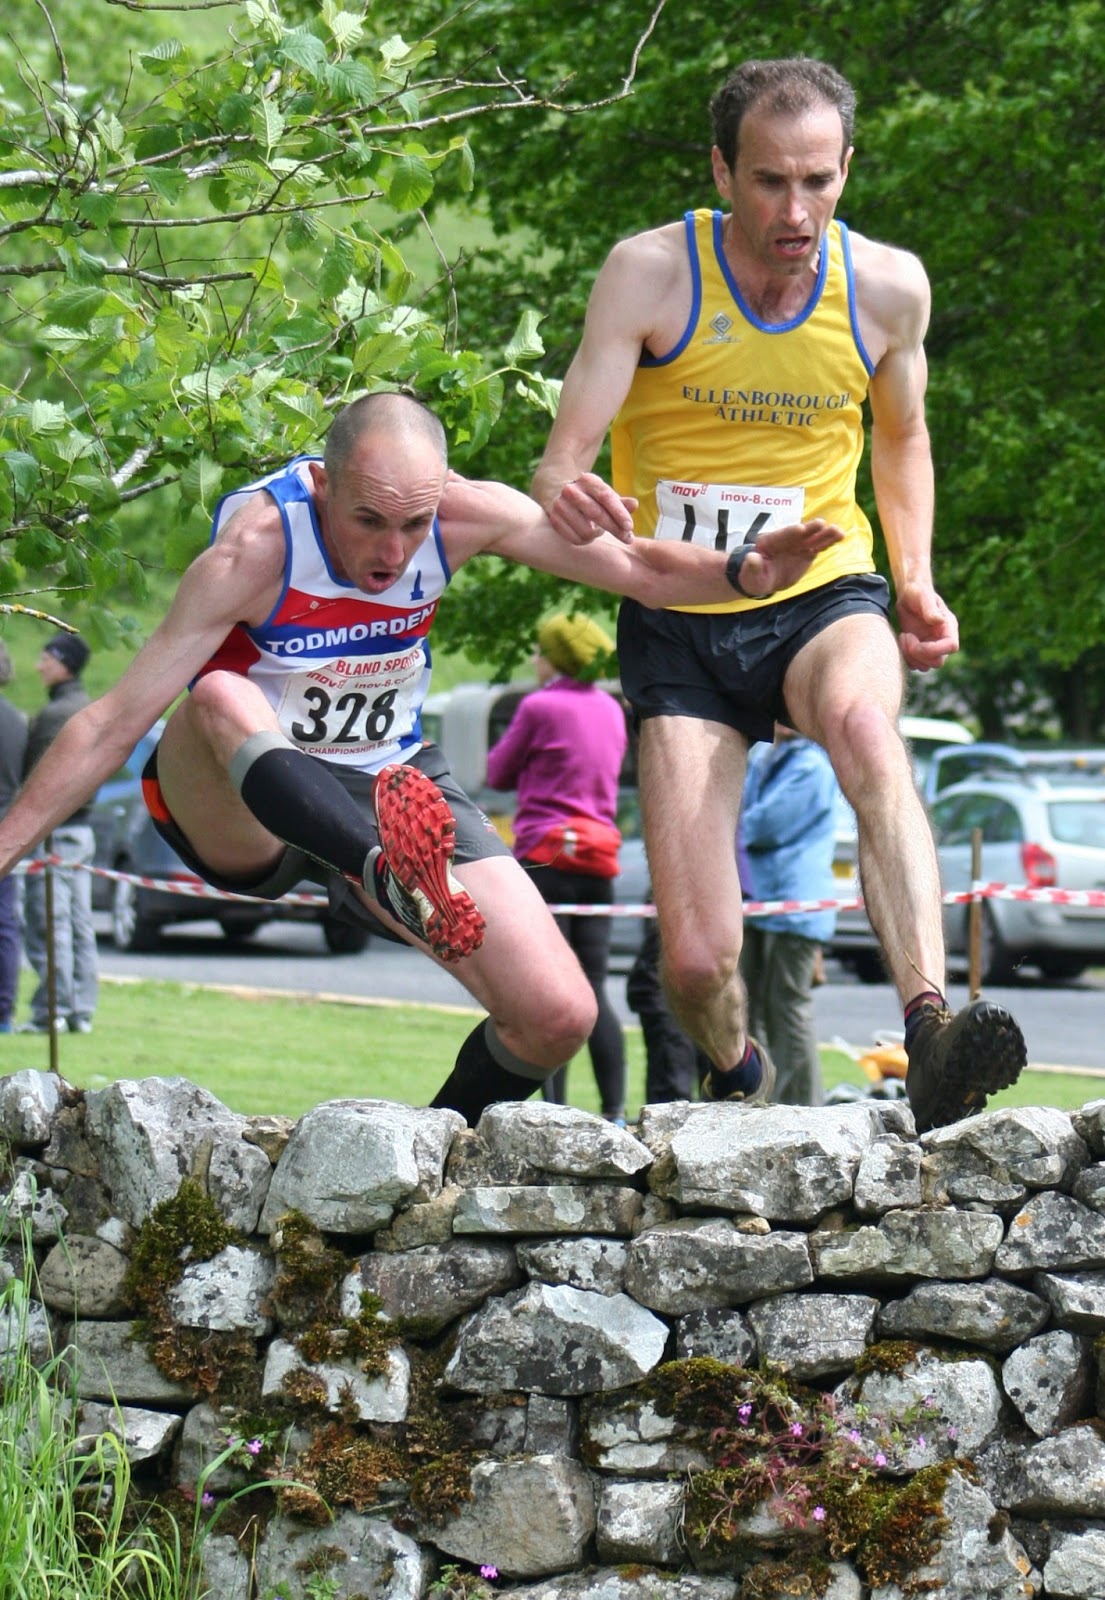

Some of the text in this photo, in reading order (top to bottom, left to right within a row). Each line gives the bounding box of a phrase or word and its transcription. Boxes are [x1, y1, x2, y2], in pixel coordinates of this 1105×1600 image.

[683, 385, 849, 410] ELLENBOROUGH
[715, 406, 819, 427] ATHLETIC
[721, 491, 792, 506] inov-8.com
[266, 603, 435, 655] TODMORDEN
[335, 660, 381, 676] BLAND
[291, 686, 400, 743] 328
[308, 743, 376, 755] CHAMPIONSHIPS
